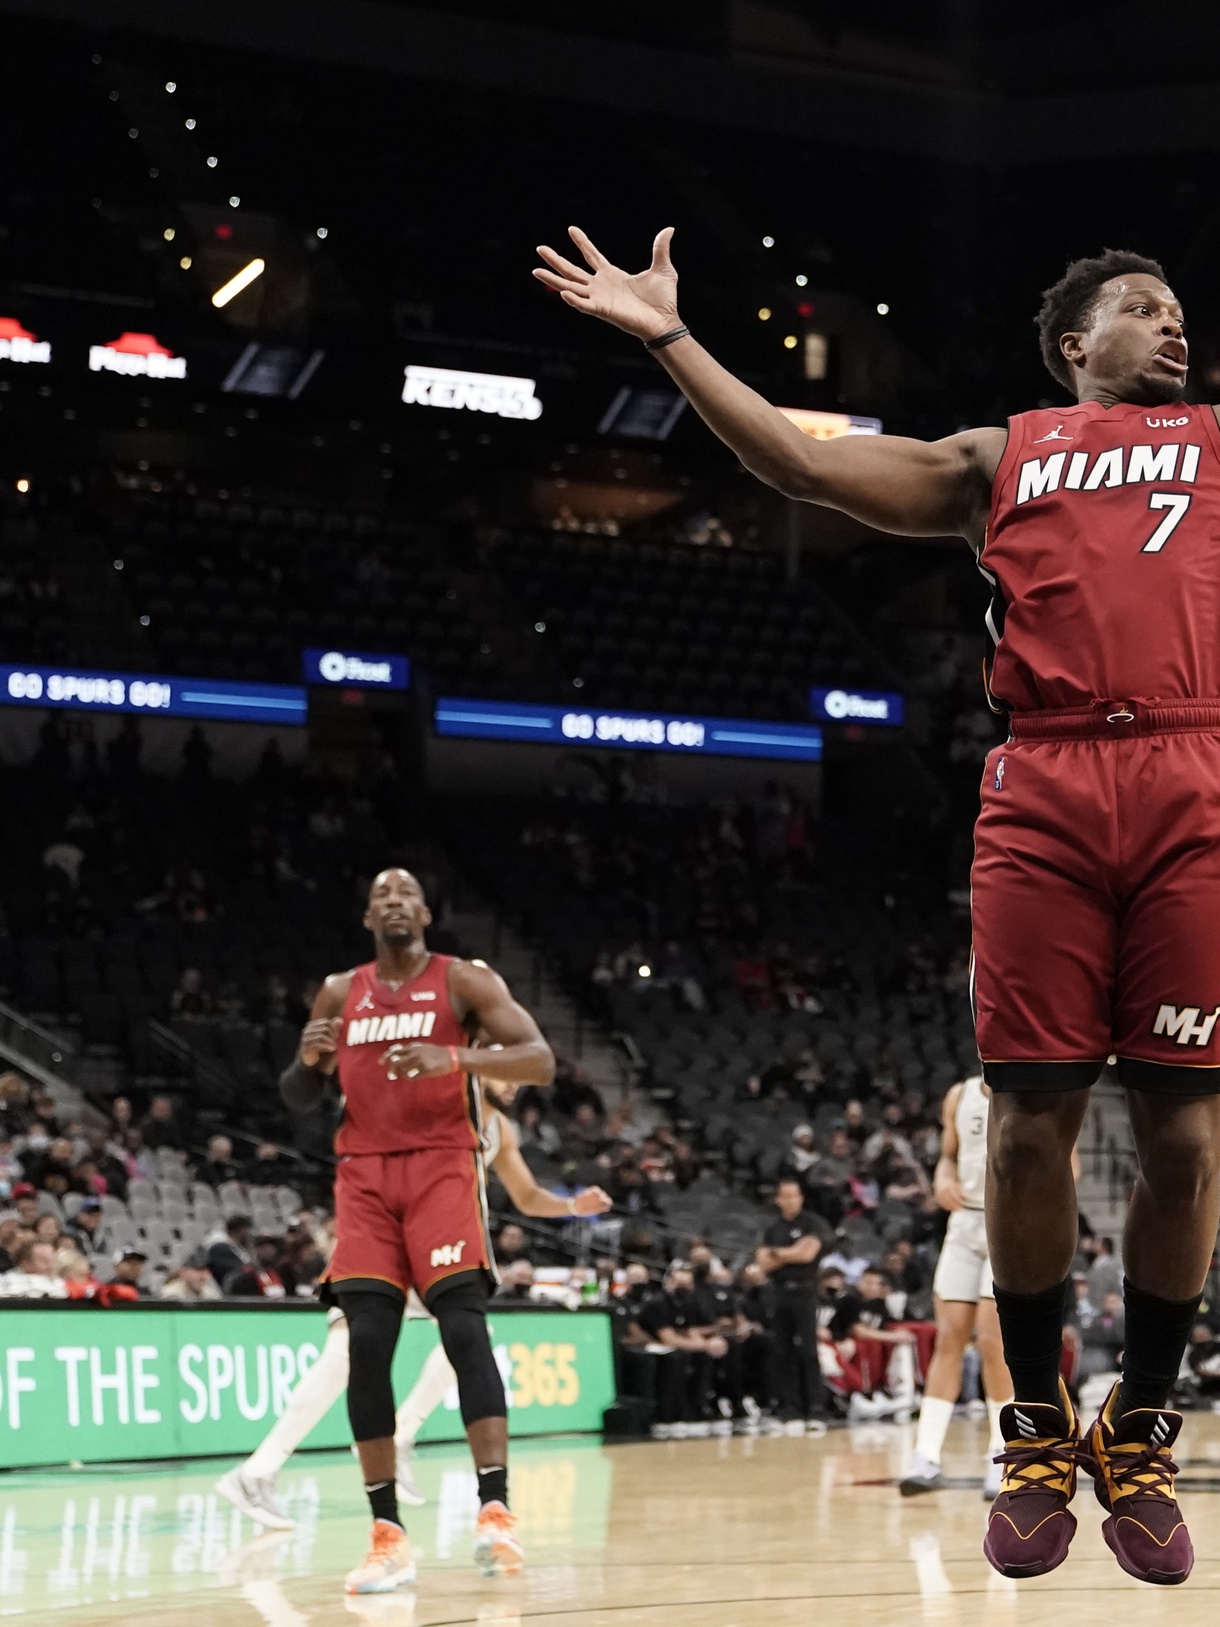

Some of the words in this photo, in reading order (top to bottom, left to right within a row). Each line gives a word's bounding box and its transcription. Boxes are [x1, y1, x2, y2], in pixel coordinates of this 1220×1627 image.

[1016, 443, 1201, 506] MIAMI
[1141, 492, 1192, 554] 7
[346, 1011, 437, 1047] MIAMI
[0, 1346, 36, 1429] F
[54, 1345, 161, 1427] THE
